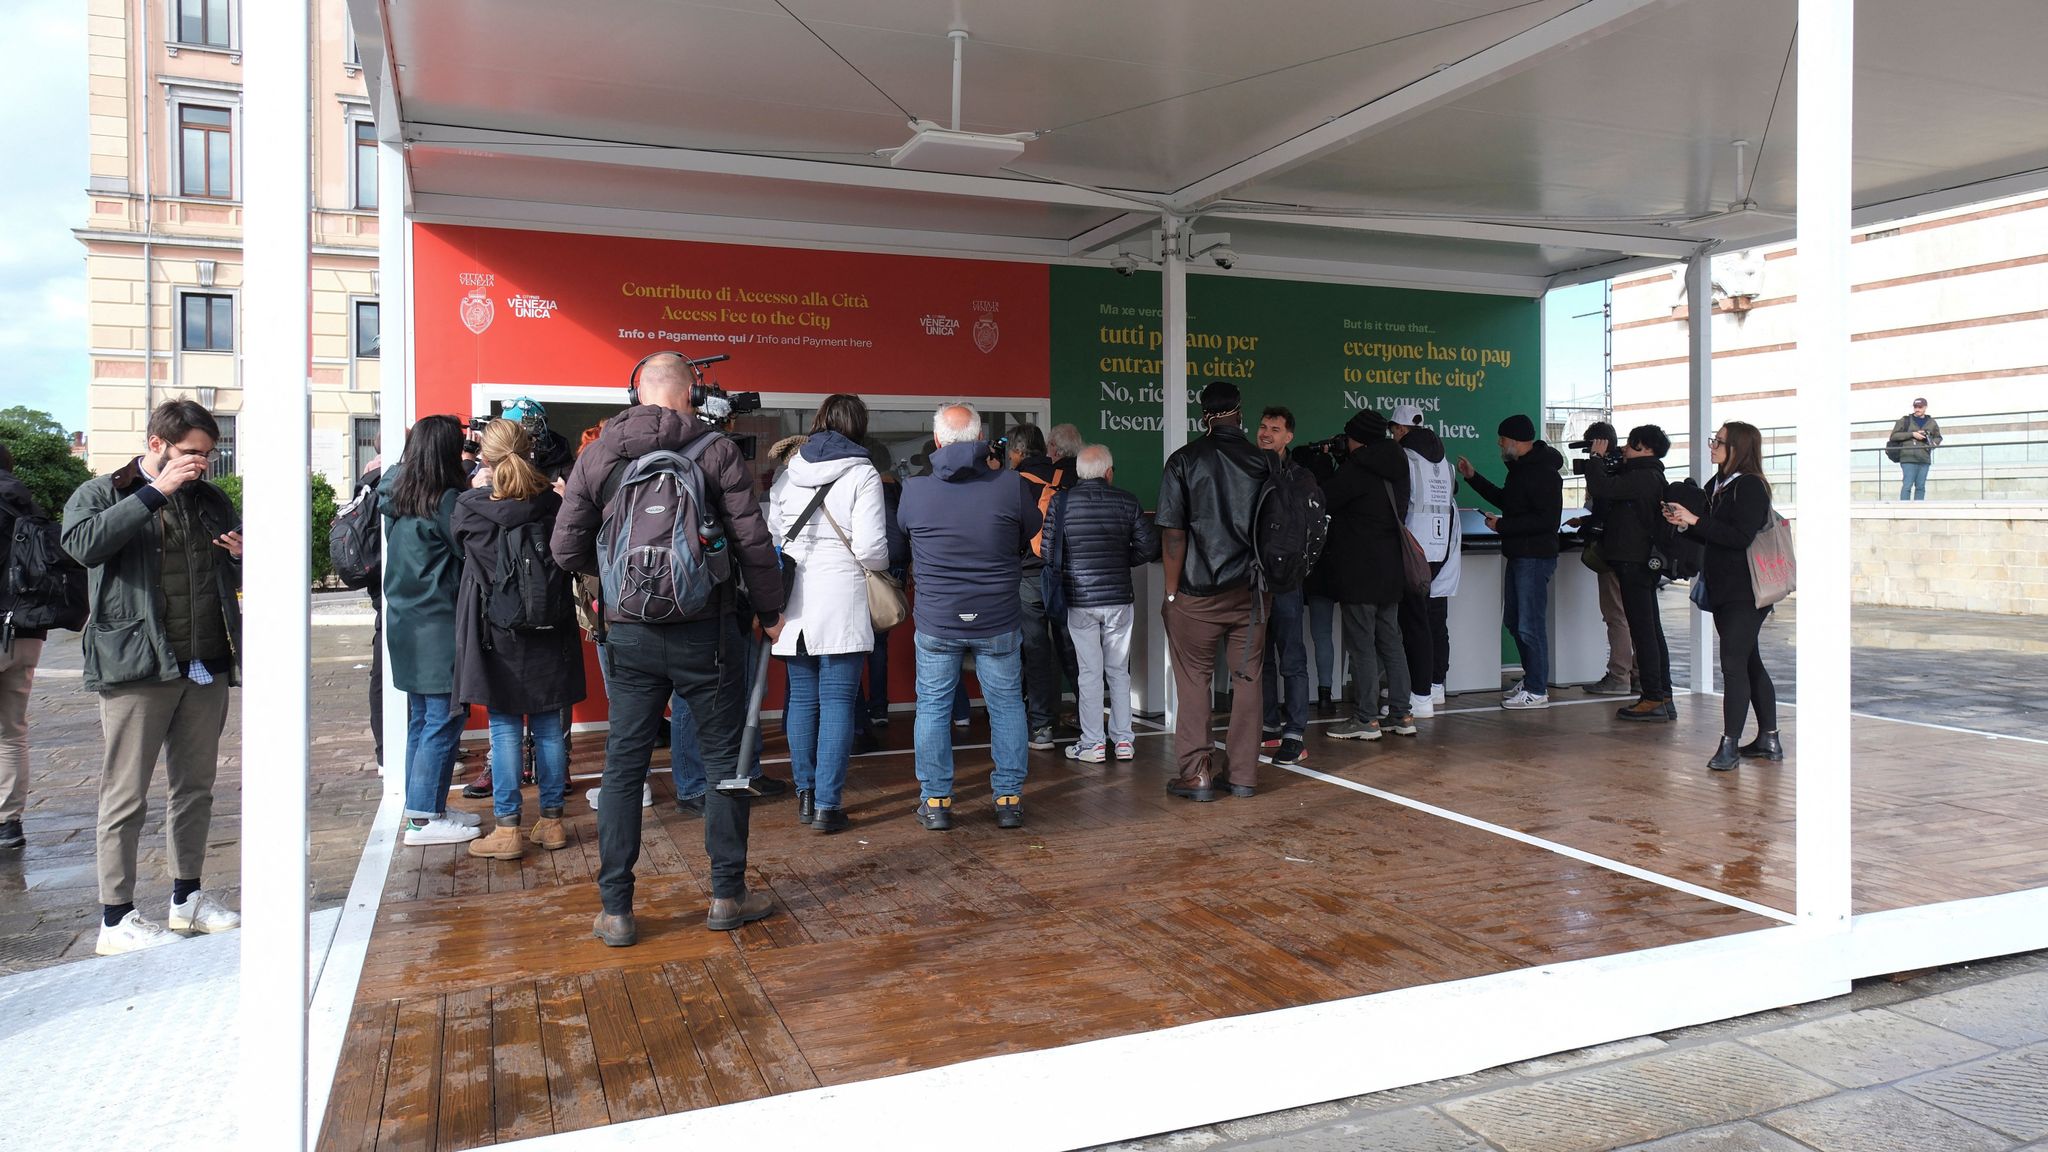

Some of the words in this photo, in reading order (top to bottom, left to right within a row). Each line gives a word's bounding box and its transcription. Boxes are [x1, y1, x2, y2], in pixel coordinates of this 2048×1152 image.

[459, 279, 495, 287] VENEZIA
[622, 282, 713, 301] Contributo
[716, 287, 732, 302] di
[736, 288, 798, 305] Accesso
[801, 292, 829, 307] alla
[832, 293, 870, 309] Città
[515, 308, 551, 319] UNICA
[661, 305, 718, 323] Access
[720, 308, 748, 324] Fee
[751, 310, 768, 325] to
[770, 311, 796, 326] the
[798, 312, 831, 330] City
[1100, 304, 1119, 315] Ma
[1122, 307, 1136, 316] xe
[926, 327, 955, 336] UNICA
[1344, 319, 1362, 329] But
[1364, 321, 1373, 330] is
[1375, 321, 1384, 330] it
[1385, 322, 1406, 332] true
[618, 328, 645, 340] Info
[648, 331, 656, 340] e
[658, 330, 726, 345] Pagamento
[728, 333, 746, 345] qui
[757, 334, 779, 344] Info
[781, 335, 801, 345] and
[802, 336, 848, 349] Payment
[850, 337, 873, 348] here
[1100, 324, 1145, 345] tutti
[1149, 330, 1222, 351] pano
[1226, 334, 1259, 354] per
[1343, 340, 1423, 362] everyone
[1427, 341, 1457, 361] has
[1460, 345, 1478, 362] to
[1481, 349, 1512, 368] pay
[1100, 356, 1164, 375] entrar
[1203, 356, 1255, 378] città?
[1343, 366, 1362, 383] to
[1366, 368, 1411, 385] enter
[1415, 367, 1442, 386] the
[1445, 368, 1485, 392] city?
[1100, 381, 1134, 405] No,
[1343, 391, 1373, 411] No,
[1439, 419, 1480, 439] here.
